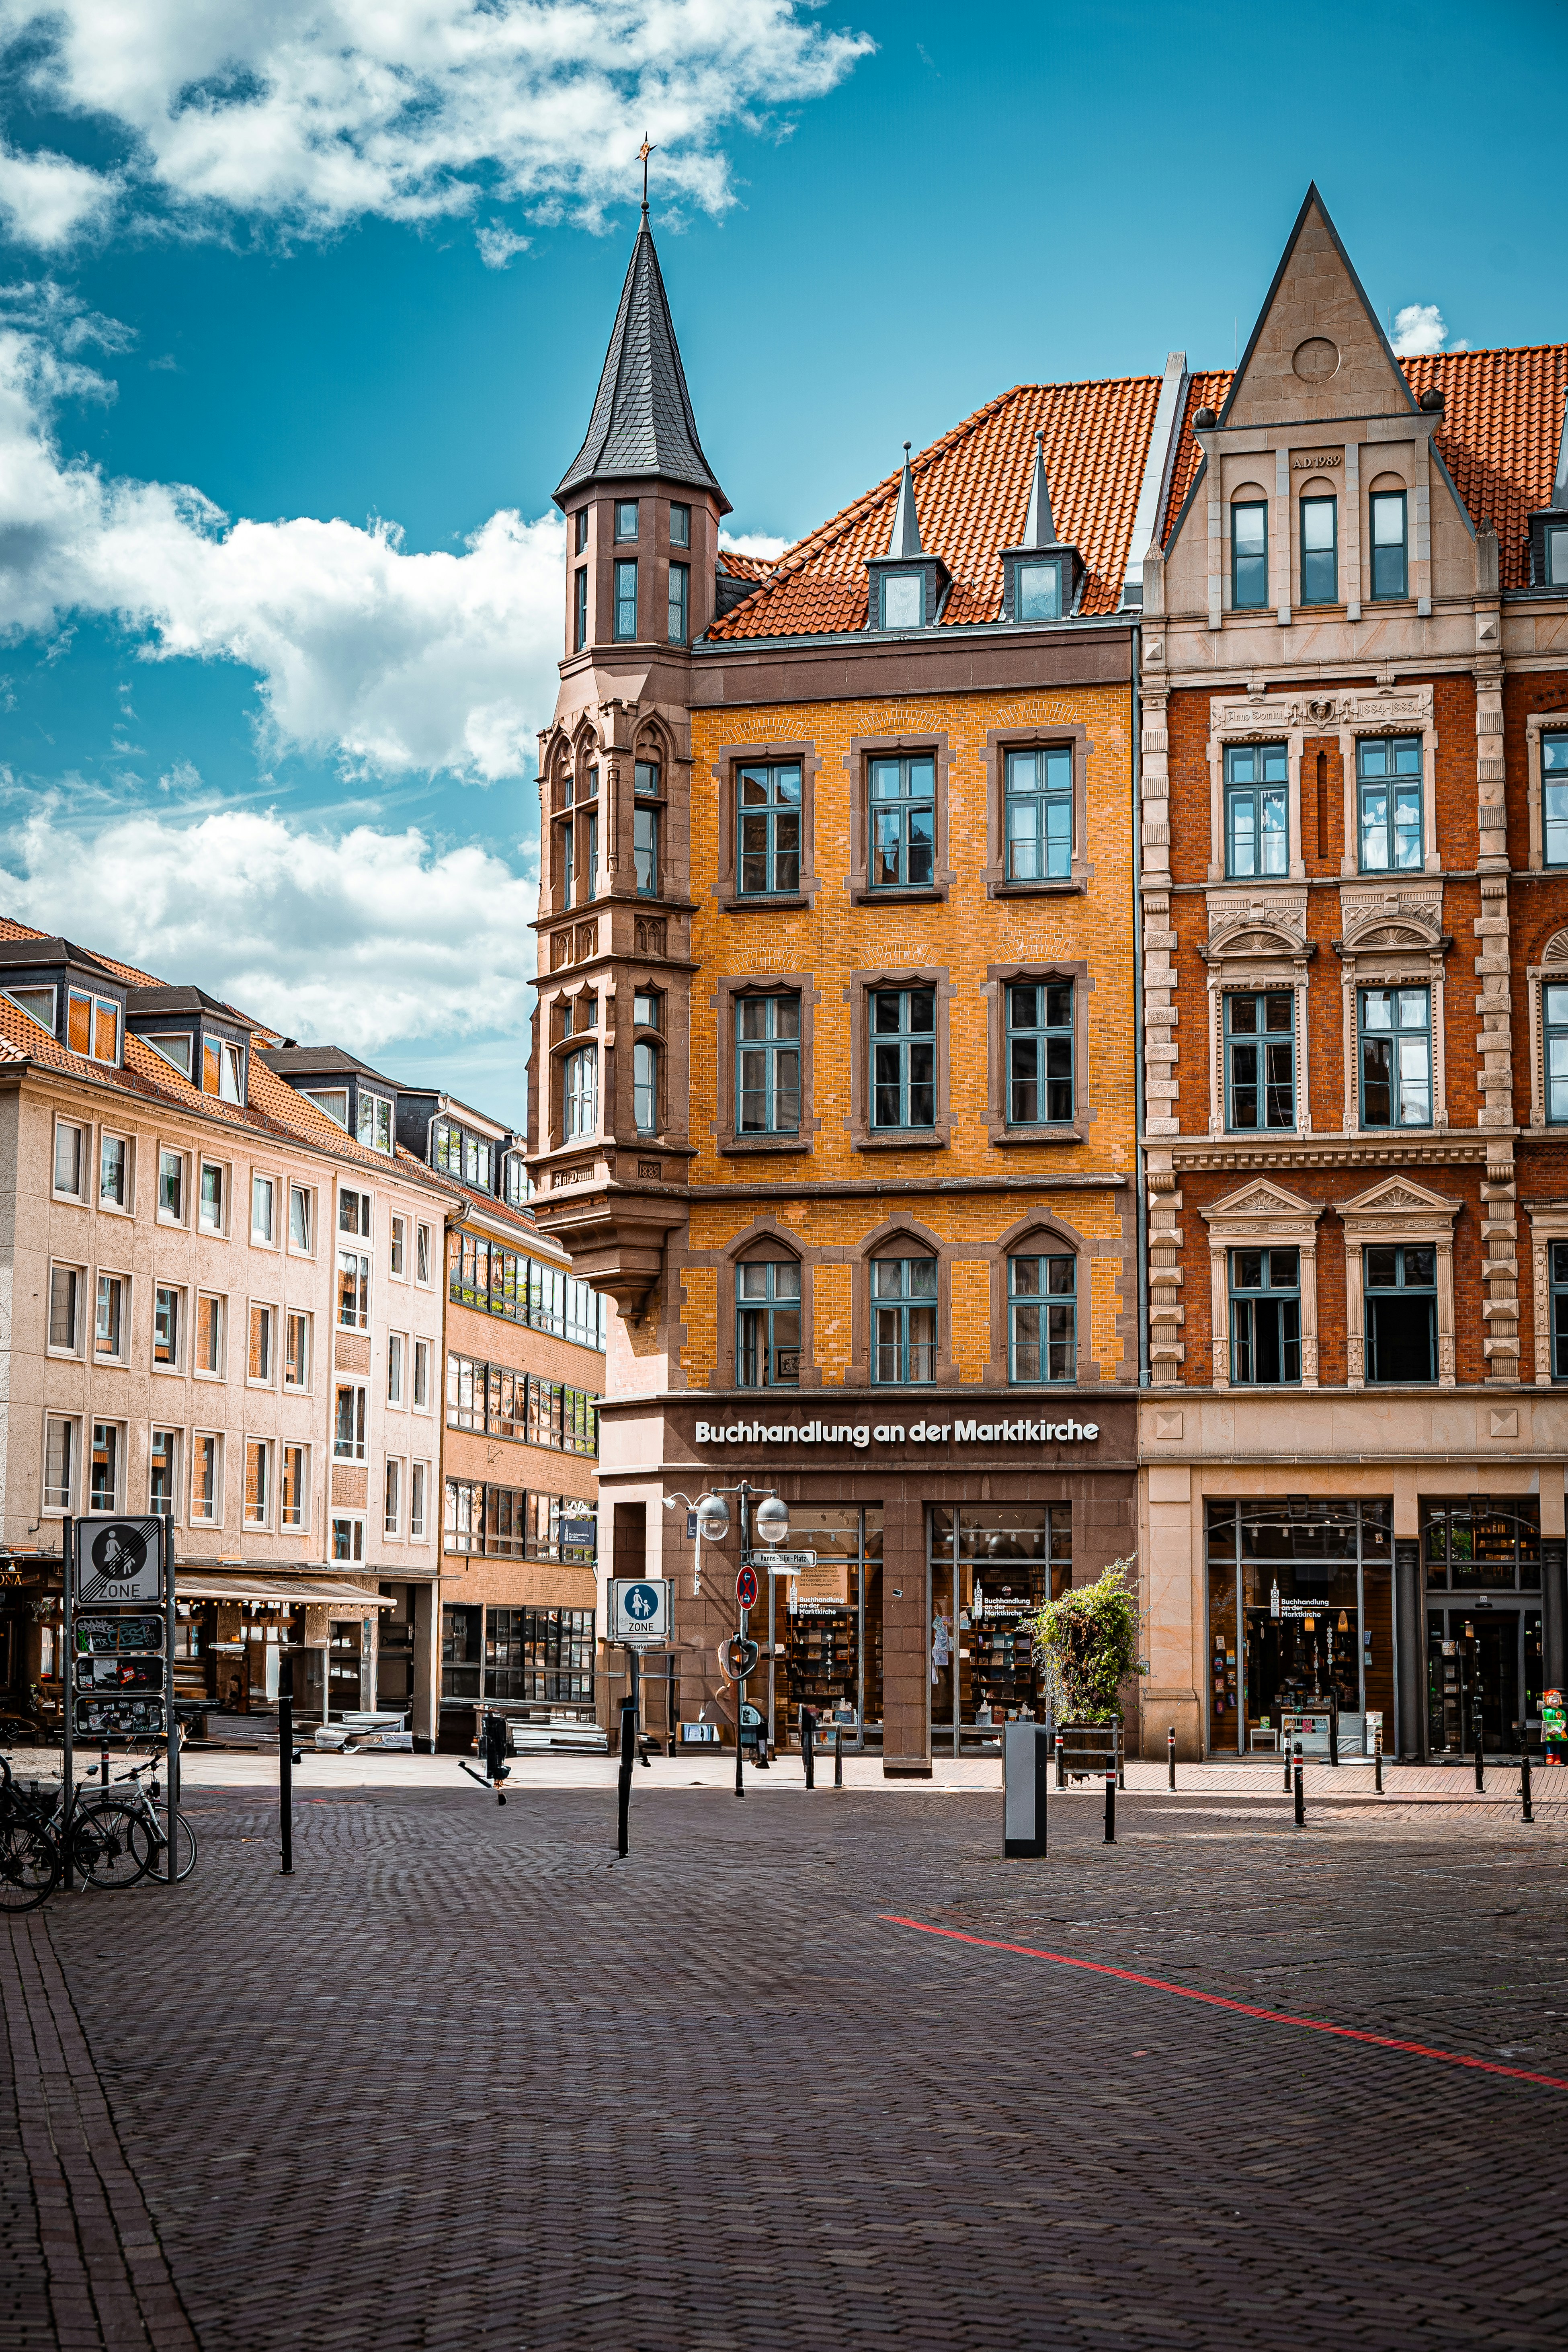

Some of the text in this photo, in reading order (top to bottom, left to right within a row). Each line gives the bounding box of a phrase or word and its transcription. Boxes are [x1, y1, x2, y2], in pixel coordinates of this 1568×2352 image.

[1314, 455, 1341, 467] 1989
[1227, 710, 1283, 722] Anno Domini
[639, 1164, 658, 1178] 1885
[696, 1419, 1099, 1447] Buchhandlung an der Marktkirche
[760, 1554, 806, 1563] Hanns-Lilje-Platz
[99, 1584, 140, 1598] ZONE
[629, 1623, 654, 1631] ZONE
